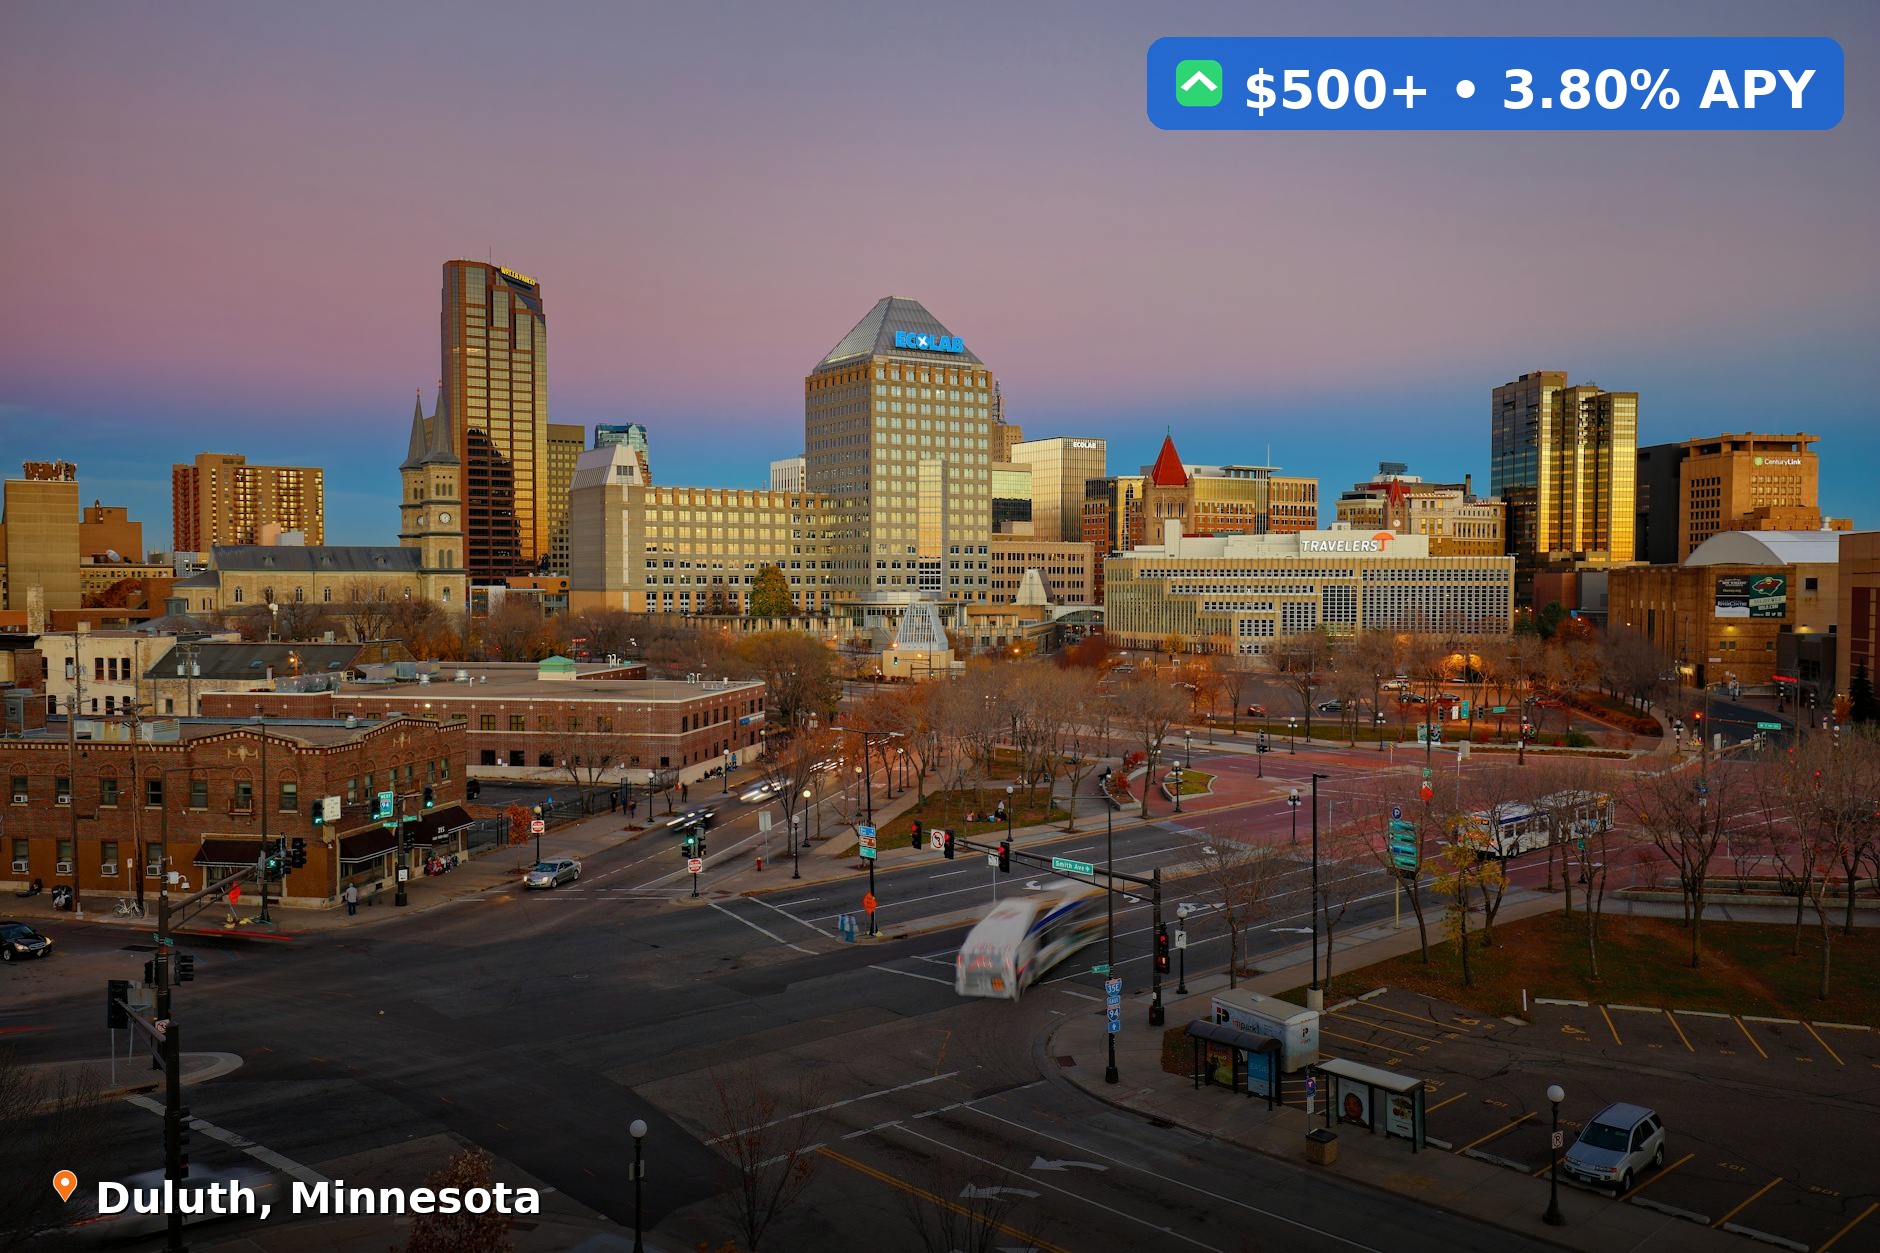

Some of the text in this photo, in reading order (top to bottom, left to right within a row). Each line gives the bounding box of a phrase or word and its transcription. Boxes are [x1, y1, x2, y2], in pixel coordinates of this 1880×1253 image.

[895, 330, 964, 353] ECOLAB
[1073, 441, 1097, 449] ECOLAB
[1764, 458, 1801, 466] CenturyLink
[1302, 540, 1378, 552] TRAVELERS
[1055, 861, 1073, 869] Smith
[1108, 983, 1120, 994] 35E
[1109, 1009, 1119, 1018] 94
